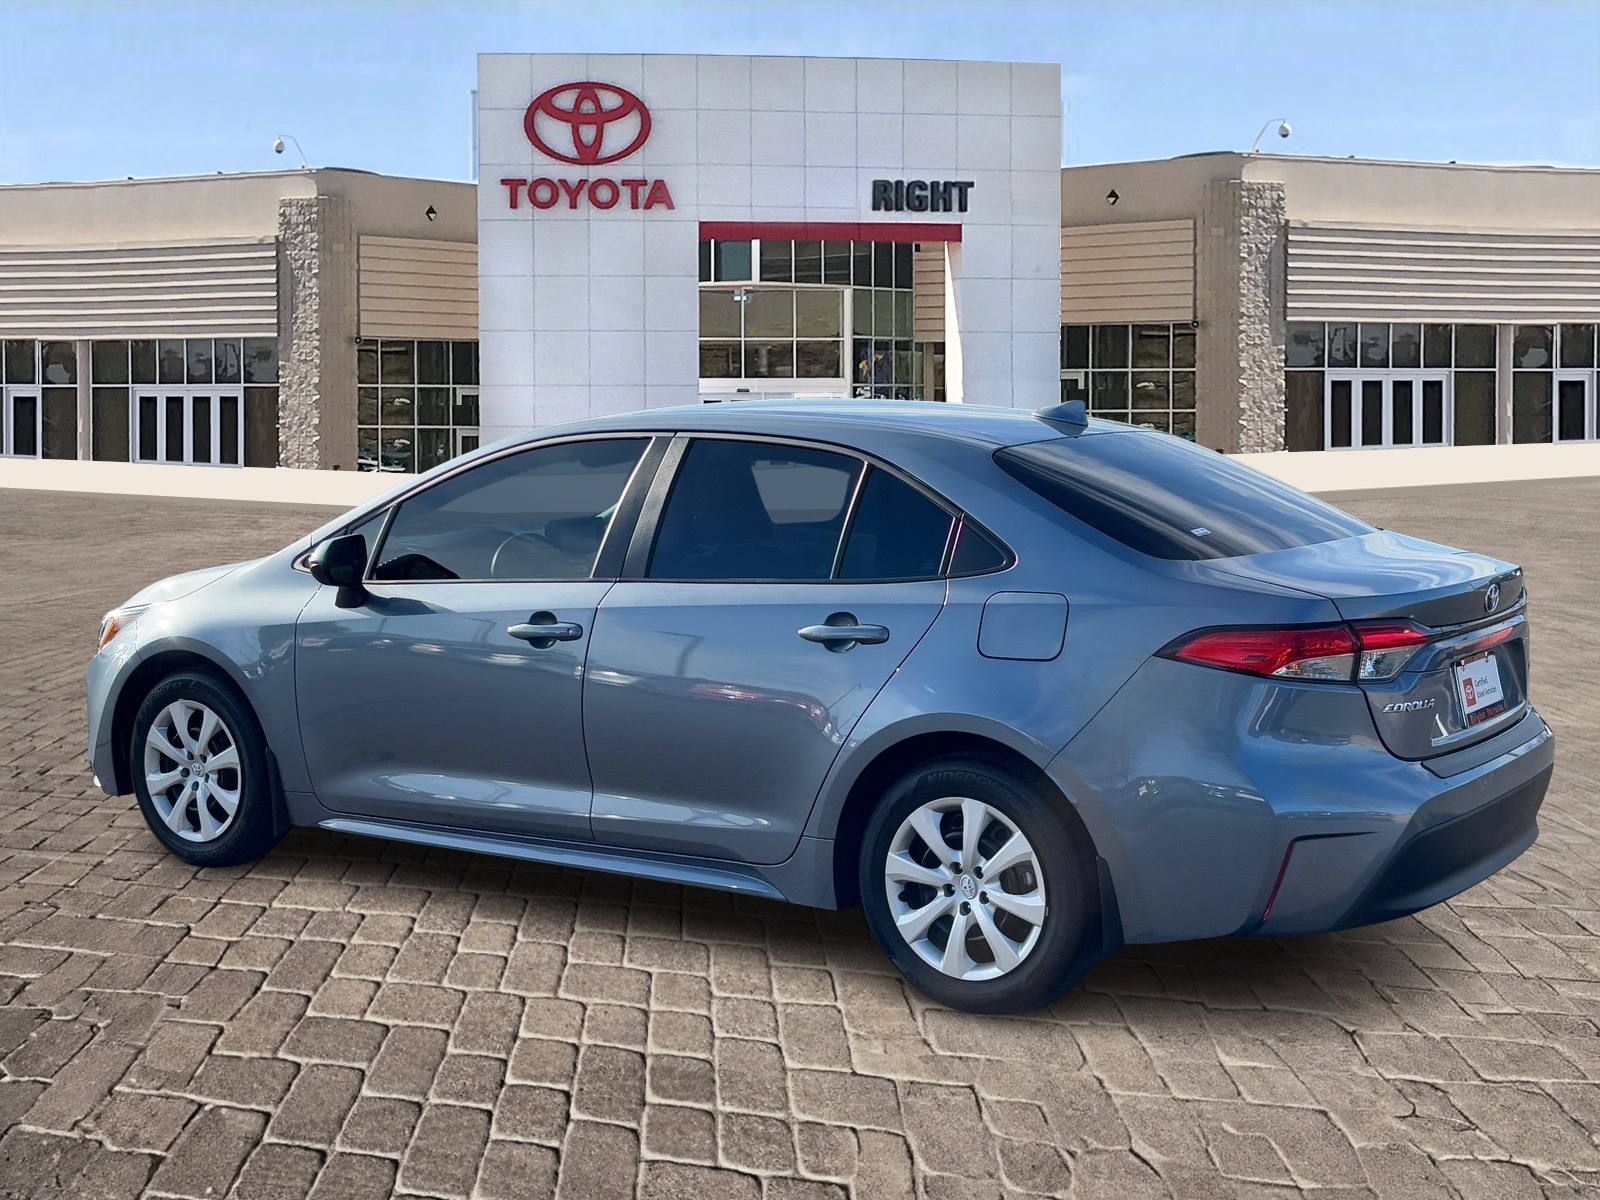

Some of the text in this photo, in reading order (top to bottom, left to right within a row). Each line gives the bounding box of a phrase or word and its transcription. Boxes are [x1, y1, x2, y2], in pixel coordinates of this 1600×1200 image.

[500, 178, 675, 210] TOYOTA
[871, 179, 974, 213] RIGHT
[1382, 698, 1435, 713] COROLLA
